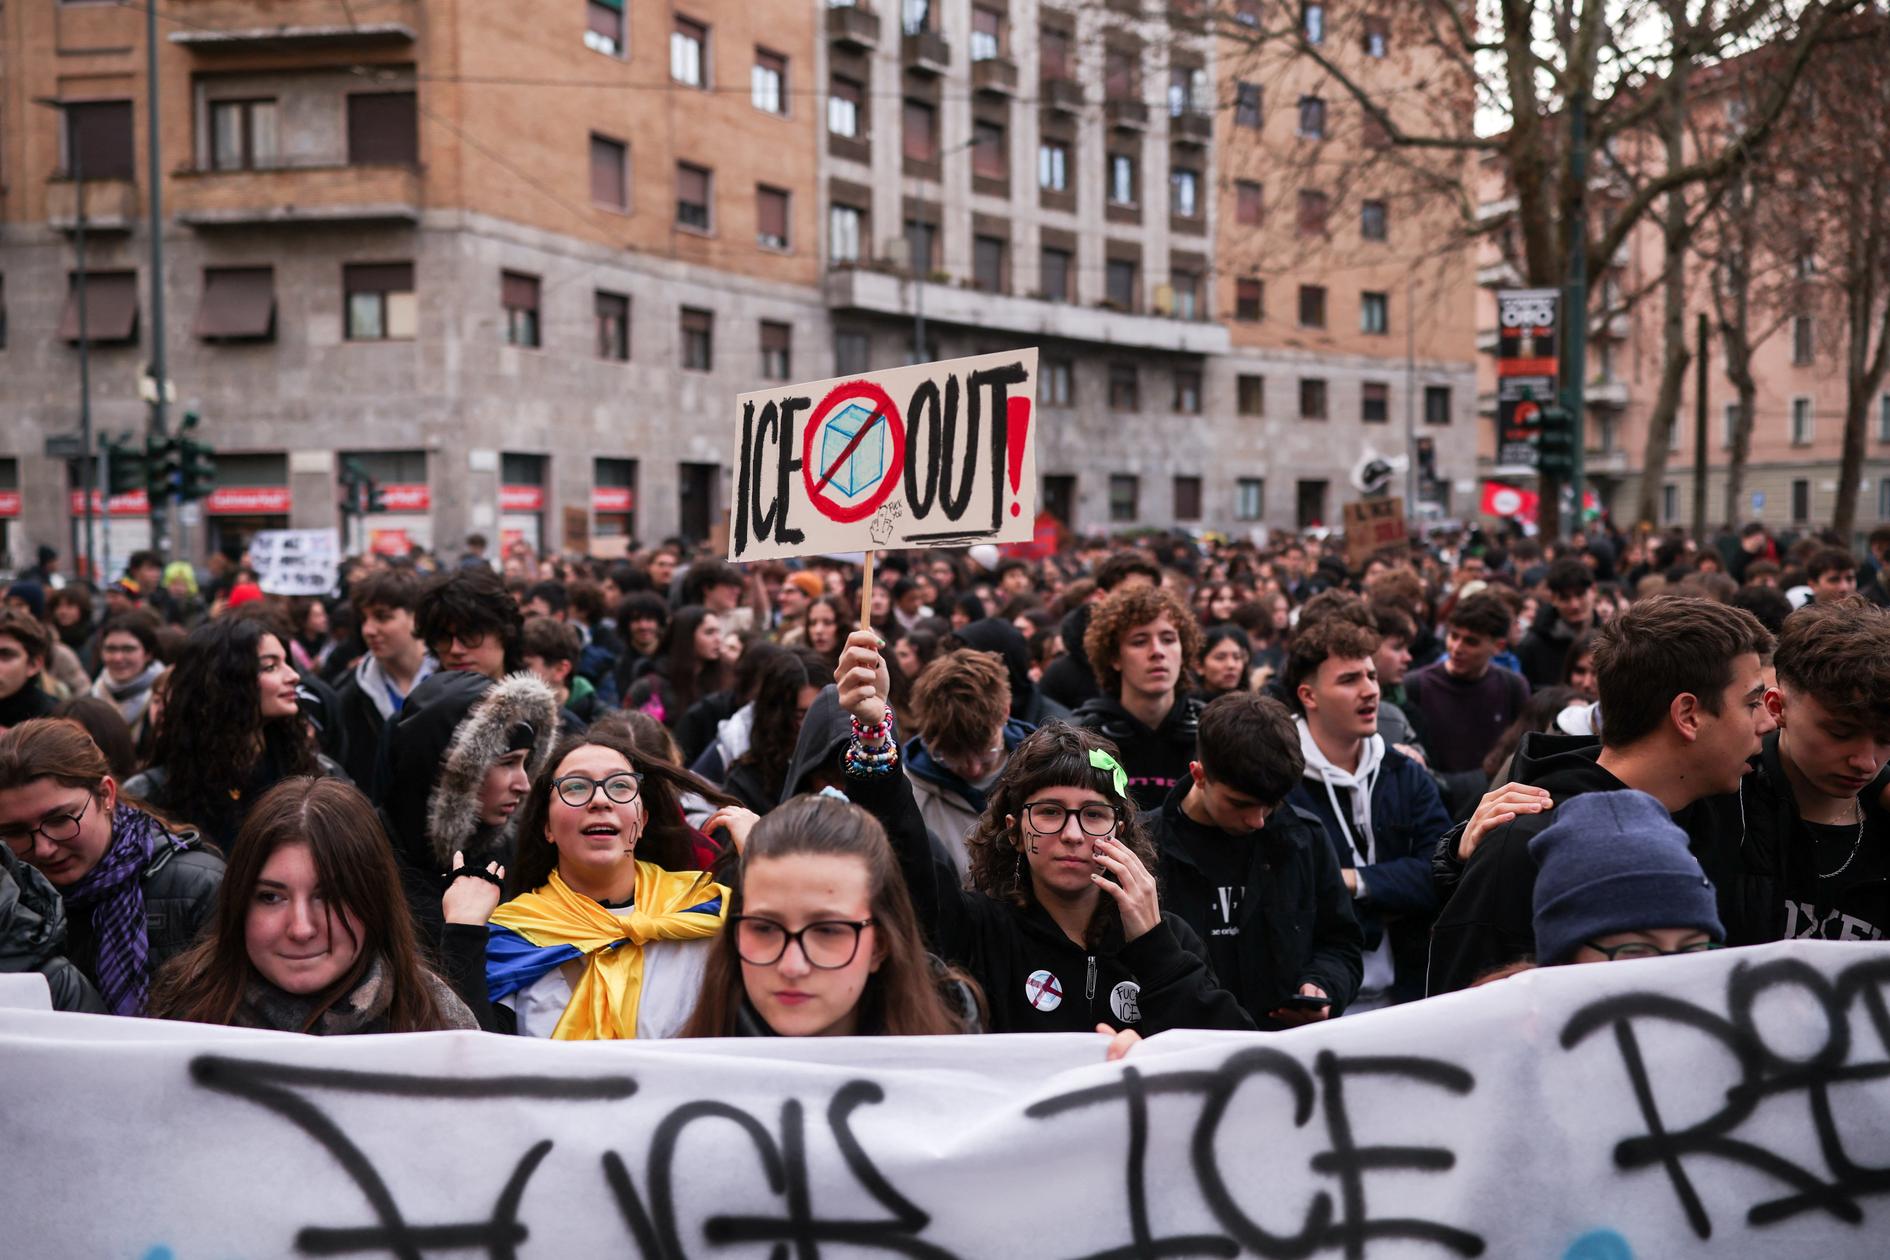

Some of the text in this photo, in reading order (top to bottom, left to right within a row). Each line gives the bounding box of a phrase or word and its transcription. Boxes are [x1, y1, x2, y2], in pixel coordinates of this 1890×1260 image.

[734, 361, 1031, 557] ICE OUT!
[1115, 986, 1140, 1001] FUC
[1022, 1046, 1487, 1260] ICE
